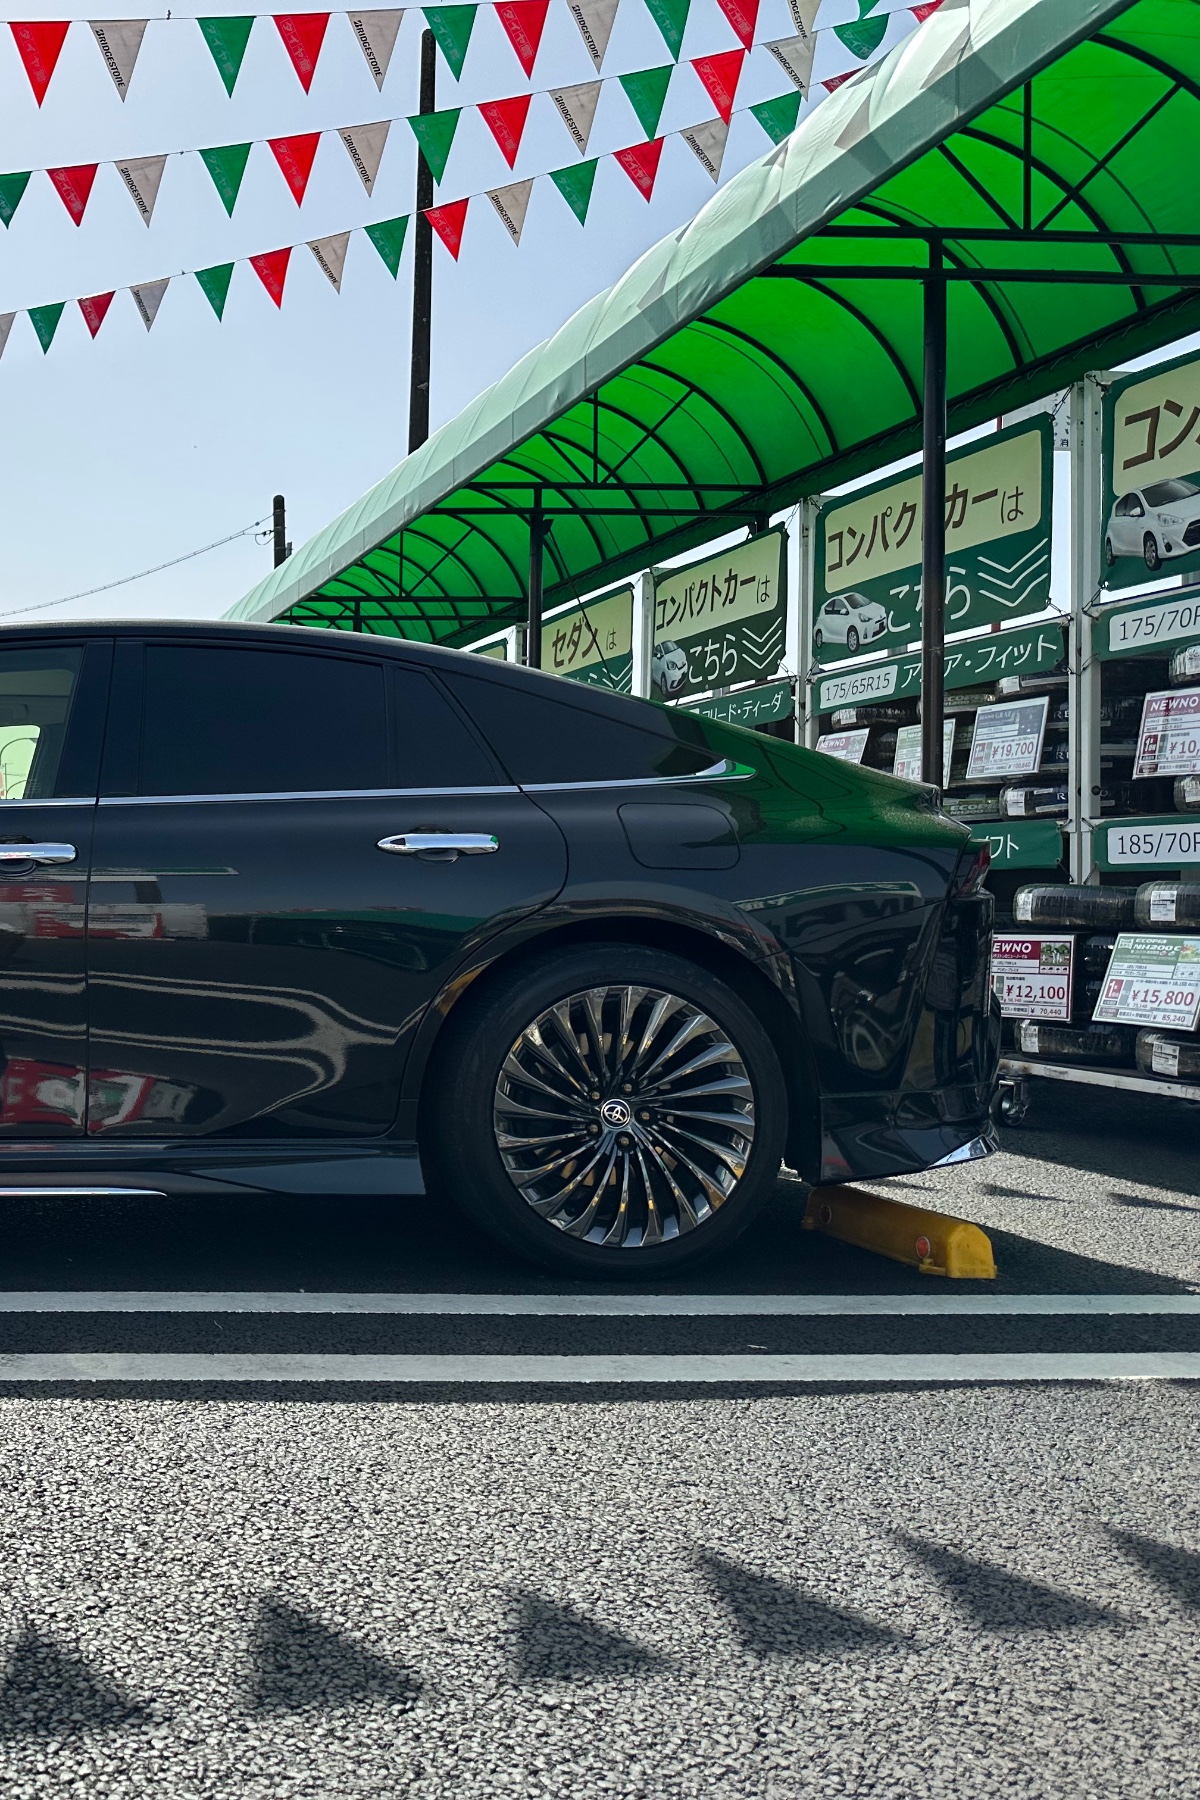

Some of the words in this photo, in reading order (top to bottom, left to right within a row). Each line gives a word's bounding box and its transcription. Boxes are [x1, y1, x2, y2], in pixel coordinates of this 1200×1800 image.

[353, 20, 382, 77] BRIDGESTONE
[572, 5, 600, 60] BRIDGESTONE
[95, 29, 126, 88] BRIDGESTONE
[771, 47, 806, 90] BRIDGESTONE
[555, 96, 585, 144] BRIDGESTONE
[343, 134, 372, 184] BRIDGESTONE
[686, 134, 717, 174] BRIDGESTONE
[121, 167, 150, 215] BRIDGESTONE
[491, 194, 520, 236] BRIDGESTONE
[313, 246, 339, 284] BRIDGESTONE
[1122, 399, 1200, 471] コン
[827, 483, 1024, 573] コンパクカーは
[656, 568, 771, 631] コンパクトカーは
[552, 617, 617, 669] セダンは
[688, 634, 737, 684] こちら
[901, 634, 1057, 688] アア・フィット
[825, 672, 891, 702] 175/65R15
[1150, 697, 1199, 712] NEWNO
[992, 742, 1033, 758] ¥19,700
[985, 834, 1019, 859] フト
[1006, 985, 1065, 1001] ¥12,100
[1131, 989, 1195, 1007] ¥15,800
[1161, 1014, 1186, 1023] 85,240
